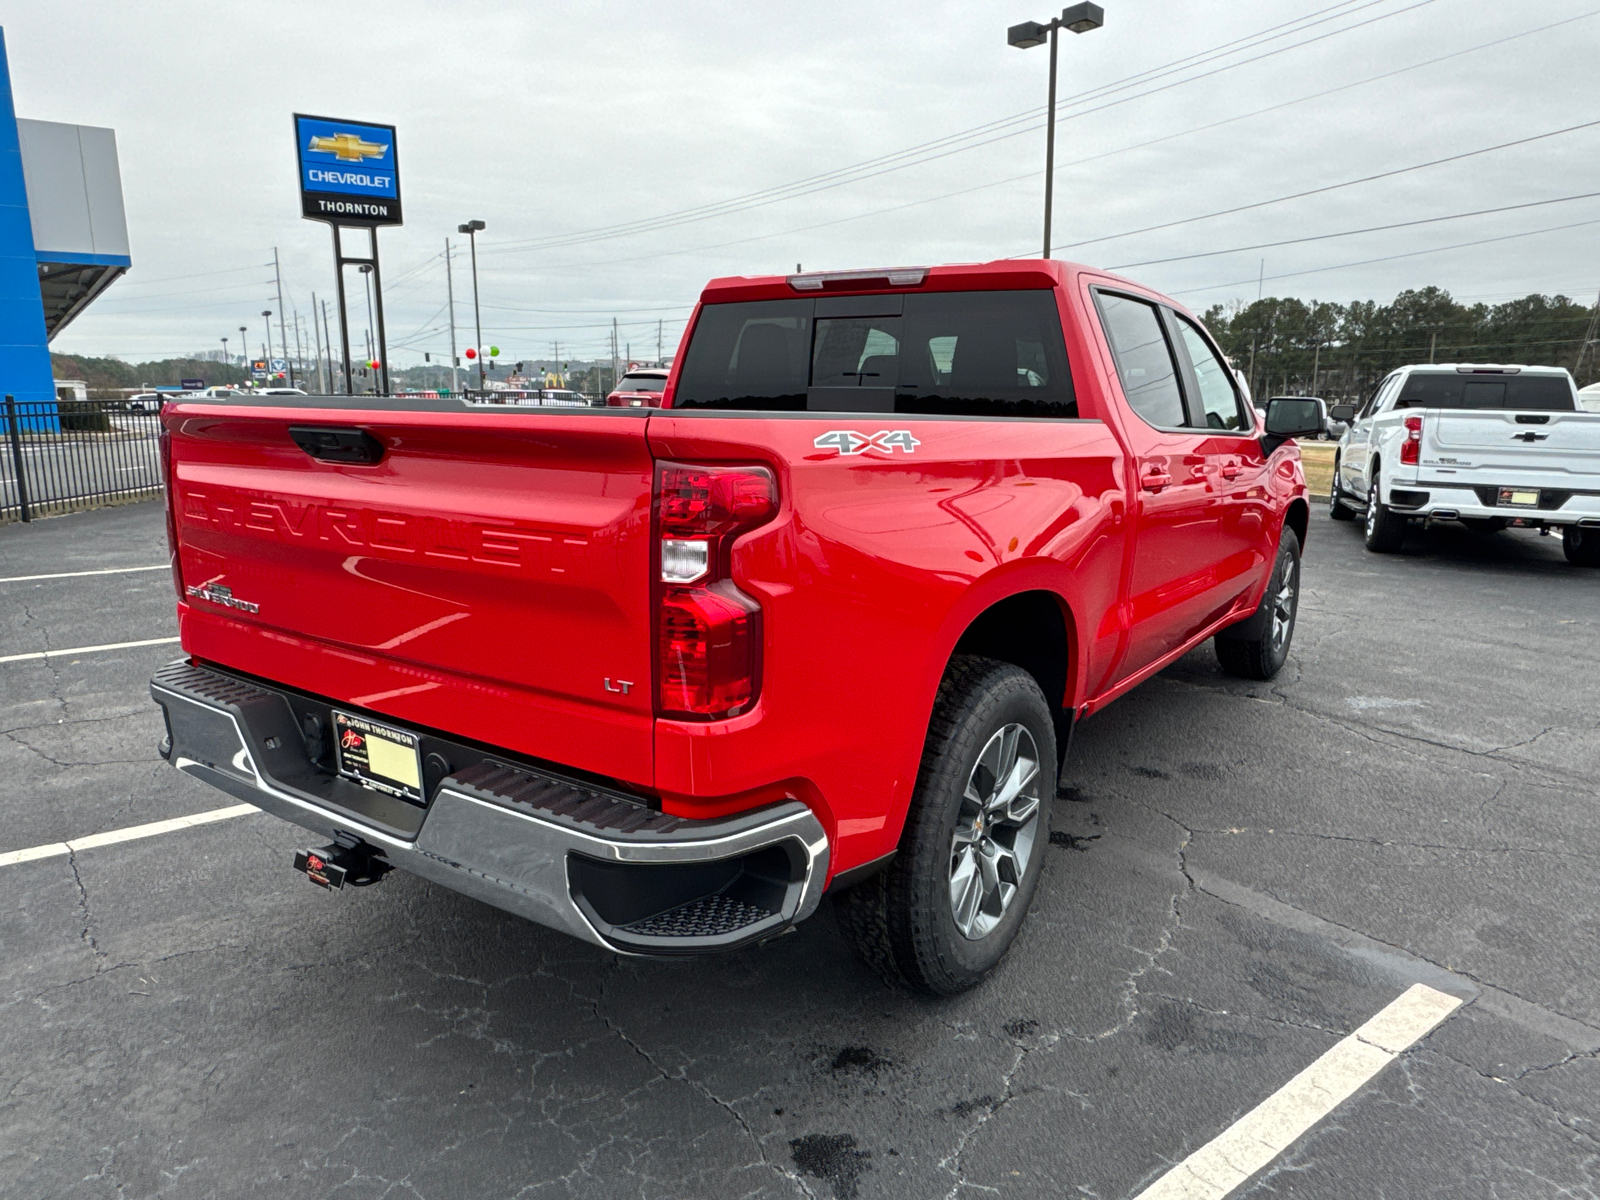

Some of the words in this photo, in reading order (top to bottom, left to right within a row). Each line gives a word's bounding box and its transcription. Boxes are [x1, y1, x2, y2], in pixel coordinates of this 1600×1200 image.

[309, 169, 391, 188] CHEVROLET
[318, 200, 388, 216] THORNTON
[181, 490, 590, 574] CHEVROLET
[185, 585, 260, 614] SILVERADO
[604, 677, 634, 694] LT
[350, 719, 370, 731] JOHN
[371, 726, 413, 745] THORNTON
